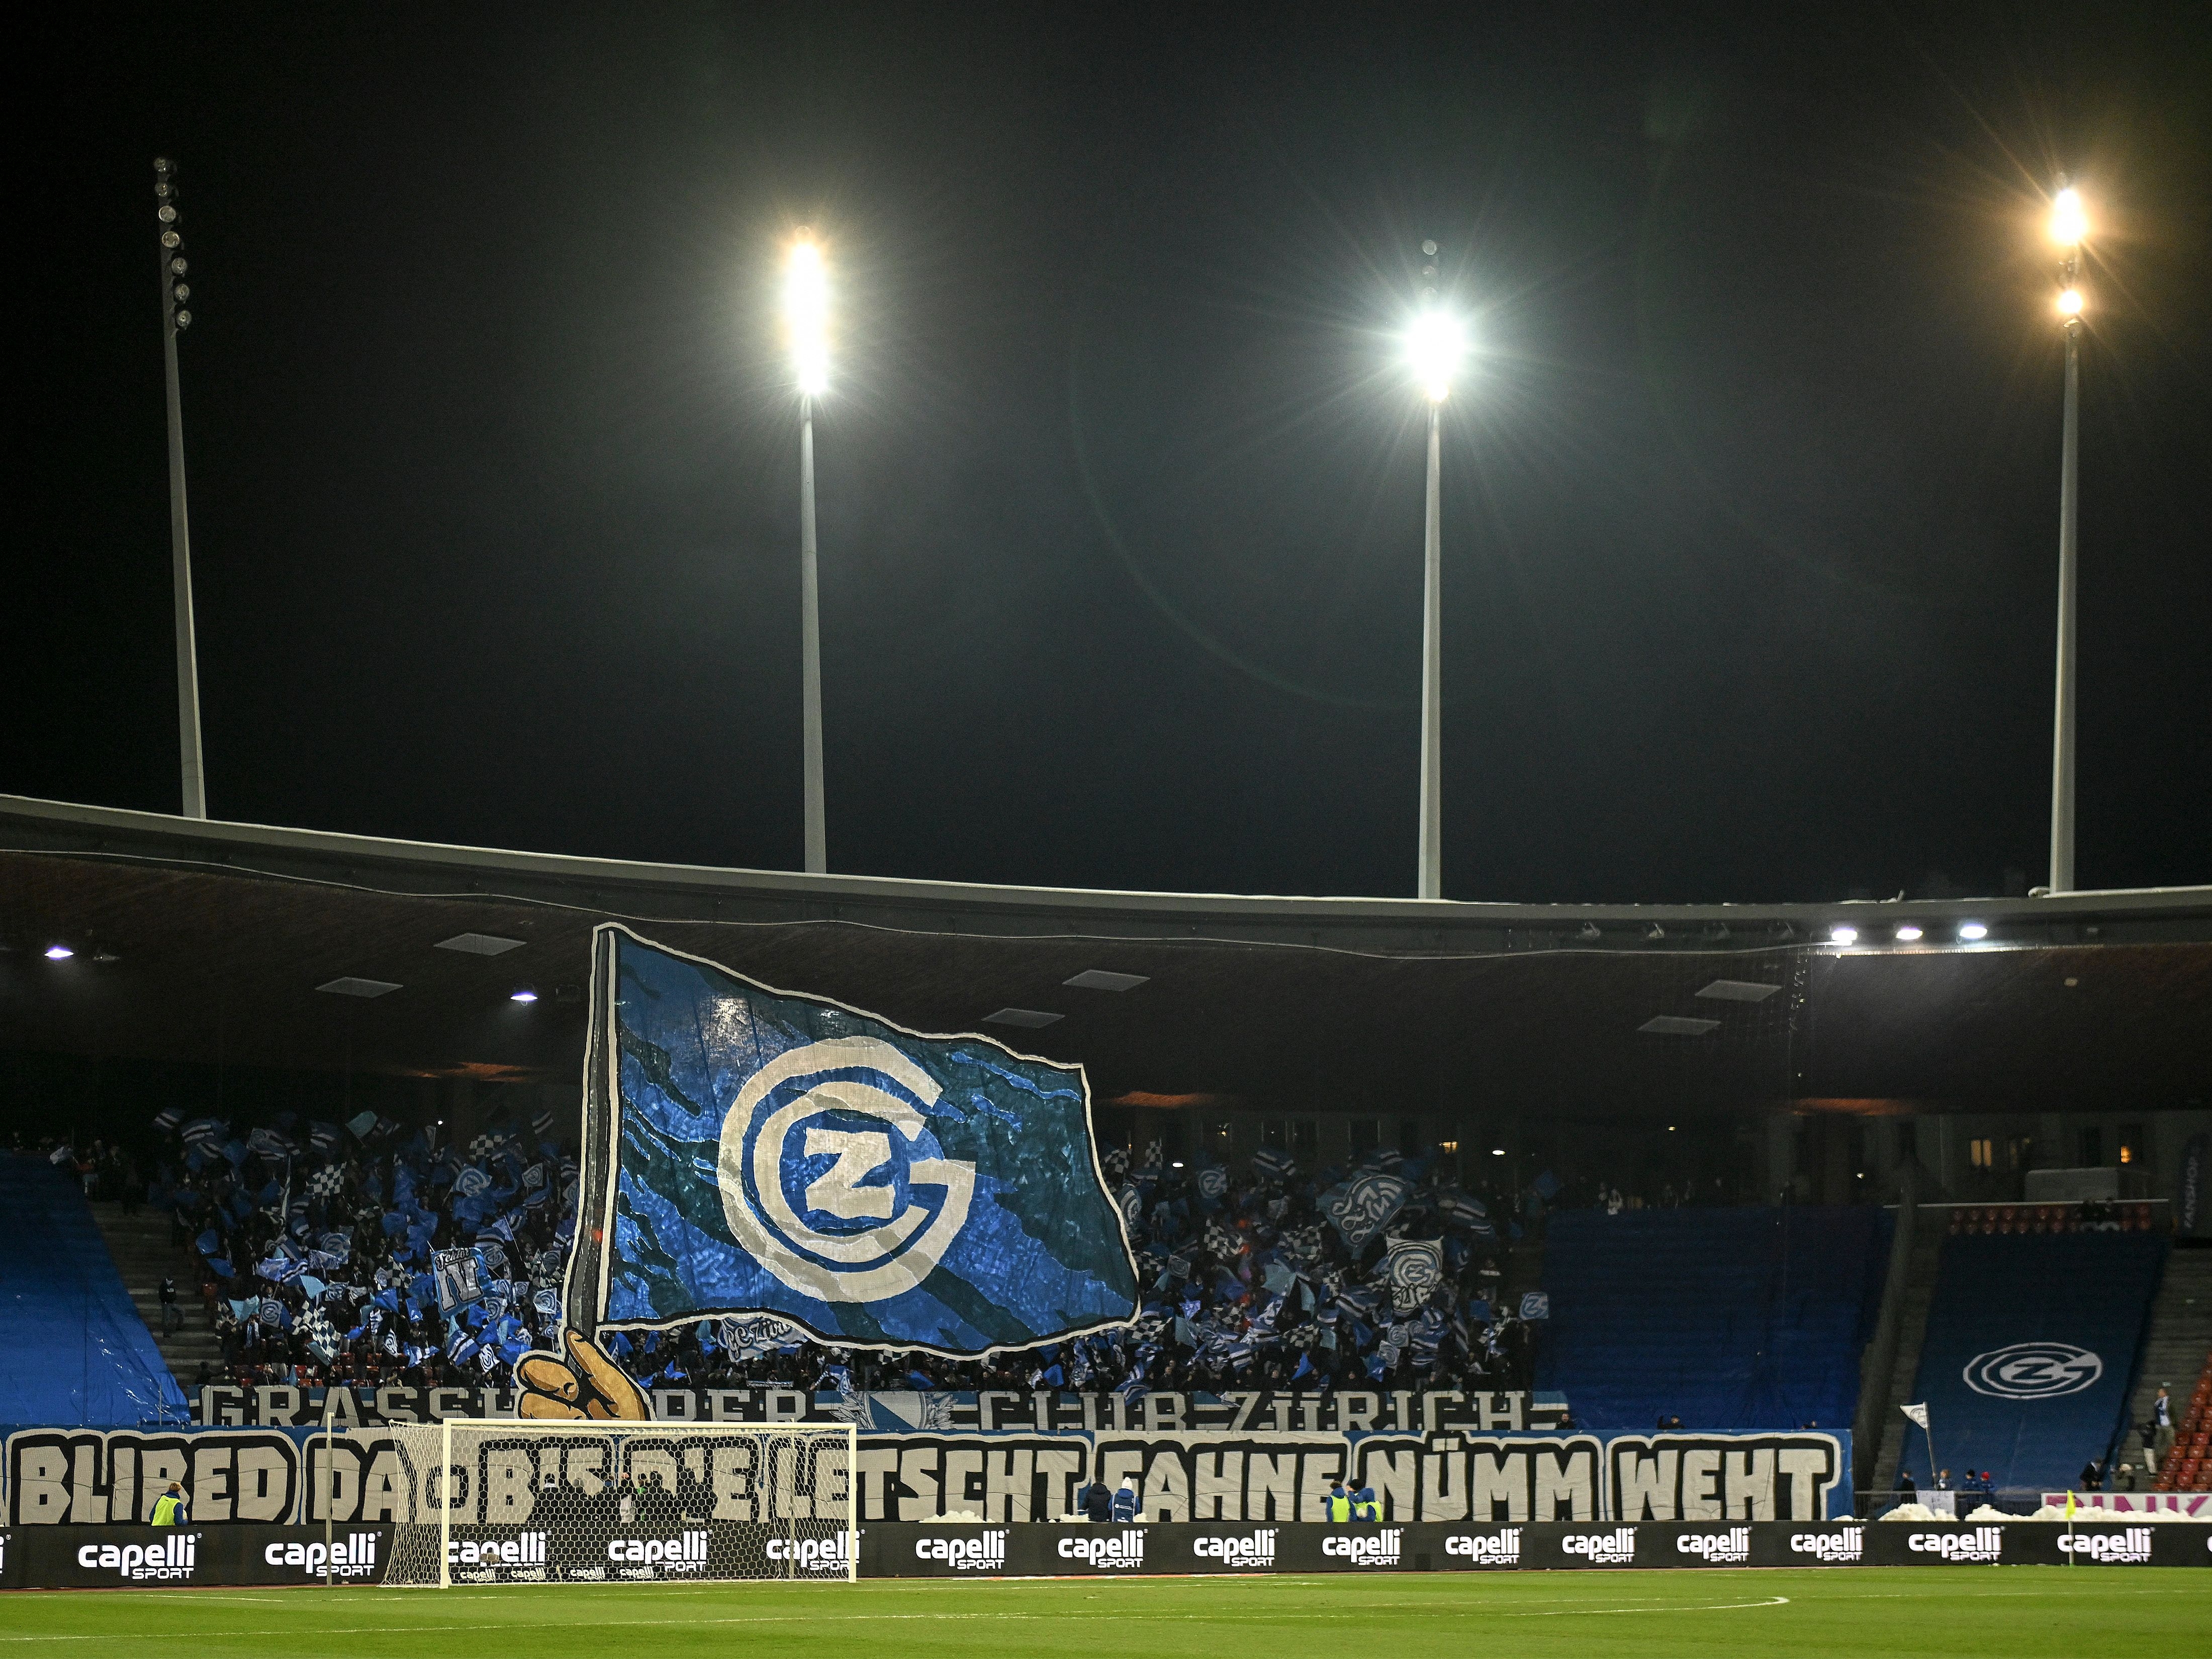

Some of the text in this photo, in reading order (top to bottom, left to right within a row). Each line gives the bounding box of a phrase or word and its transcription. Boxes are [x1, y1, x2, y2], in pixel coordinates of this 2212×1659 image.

[1363, 1437, 1594, 1522] NÜMM
[1617, 1446, 1828, 1522] WEHT
[608, 1531, 707, 1564] capelli
[916, 1531, 1004, 1566] capelli
[1058, 1530, 1143, 1565] capelli
[1194, 1530, 1275, 1563] capelli
[1323, 1529, 1400, 1562] capelli
[1445, 1529, 1519, 1561] capelli
[1562, 1528, 1634, 1560] capelli
[1677, 1528, 1748, 1559] capelli
[1791, 1527, 1862, 1558] capelli
[1909, 1527, 2000, 1558] capelli
[2058, 1528, 2151, 1559] capelli
[78, 1535, 195, 1576] capelli
[265, 1533, 376, 1573] capelli
[1480, 1555, 1519, 1564] SPORT
[1596, 1553, 1634, 1563] SPORT
[1710, 1552, 1748, 1562] SPORT
[1823, 1551, 1862, 1561] SPORT
[1950, 1551, 2001, 1560] SPORT
[2100, 1552, 2151, 1562] SPORT
[655, 1561, 707, 1572] PORT
[957, 1559, 1004, 1570] SPORT
[1098, 1558, 1143, 1568] SPORT
[1232, 1557, 1275, 1566] SPORT
[1358, 1556, 1400, 1565] SPORT
[133, 1568, 194, 1579] SPORT
[316, 1565, 375, 1577] SPORT
[459, 1569, 496, 1581] capelli
[511, 1568, 546, 1580] capelli
[570, 1566, 605, 1579] capelli
[620, 1565, 654, 1578] capelli
